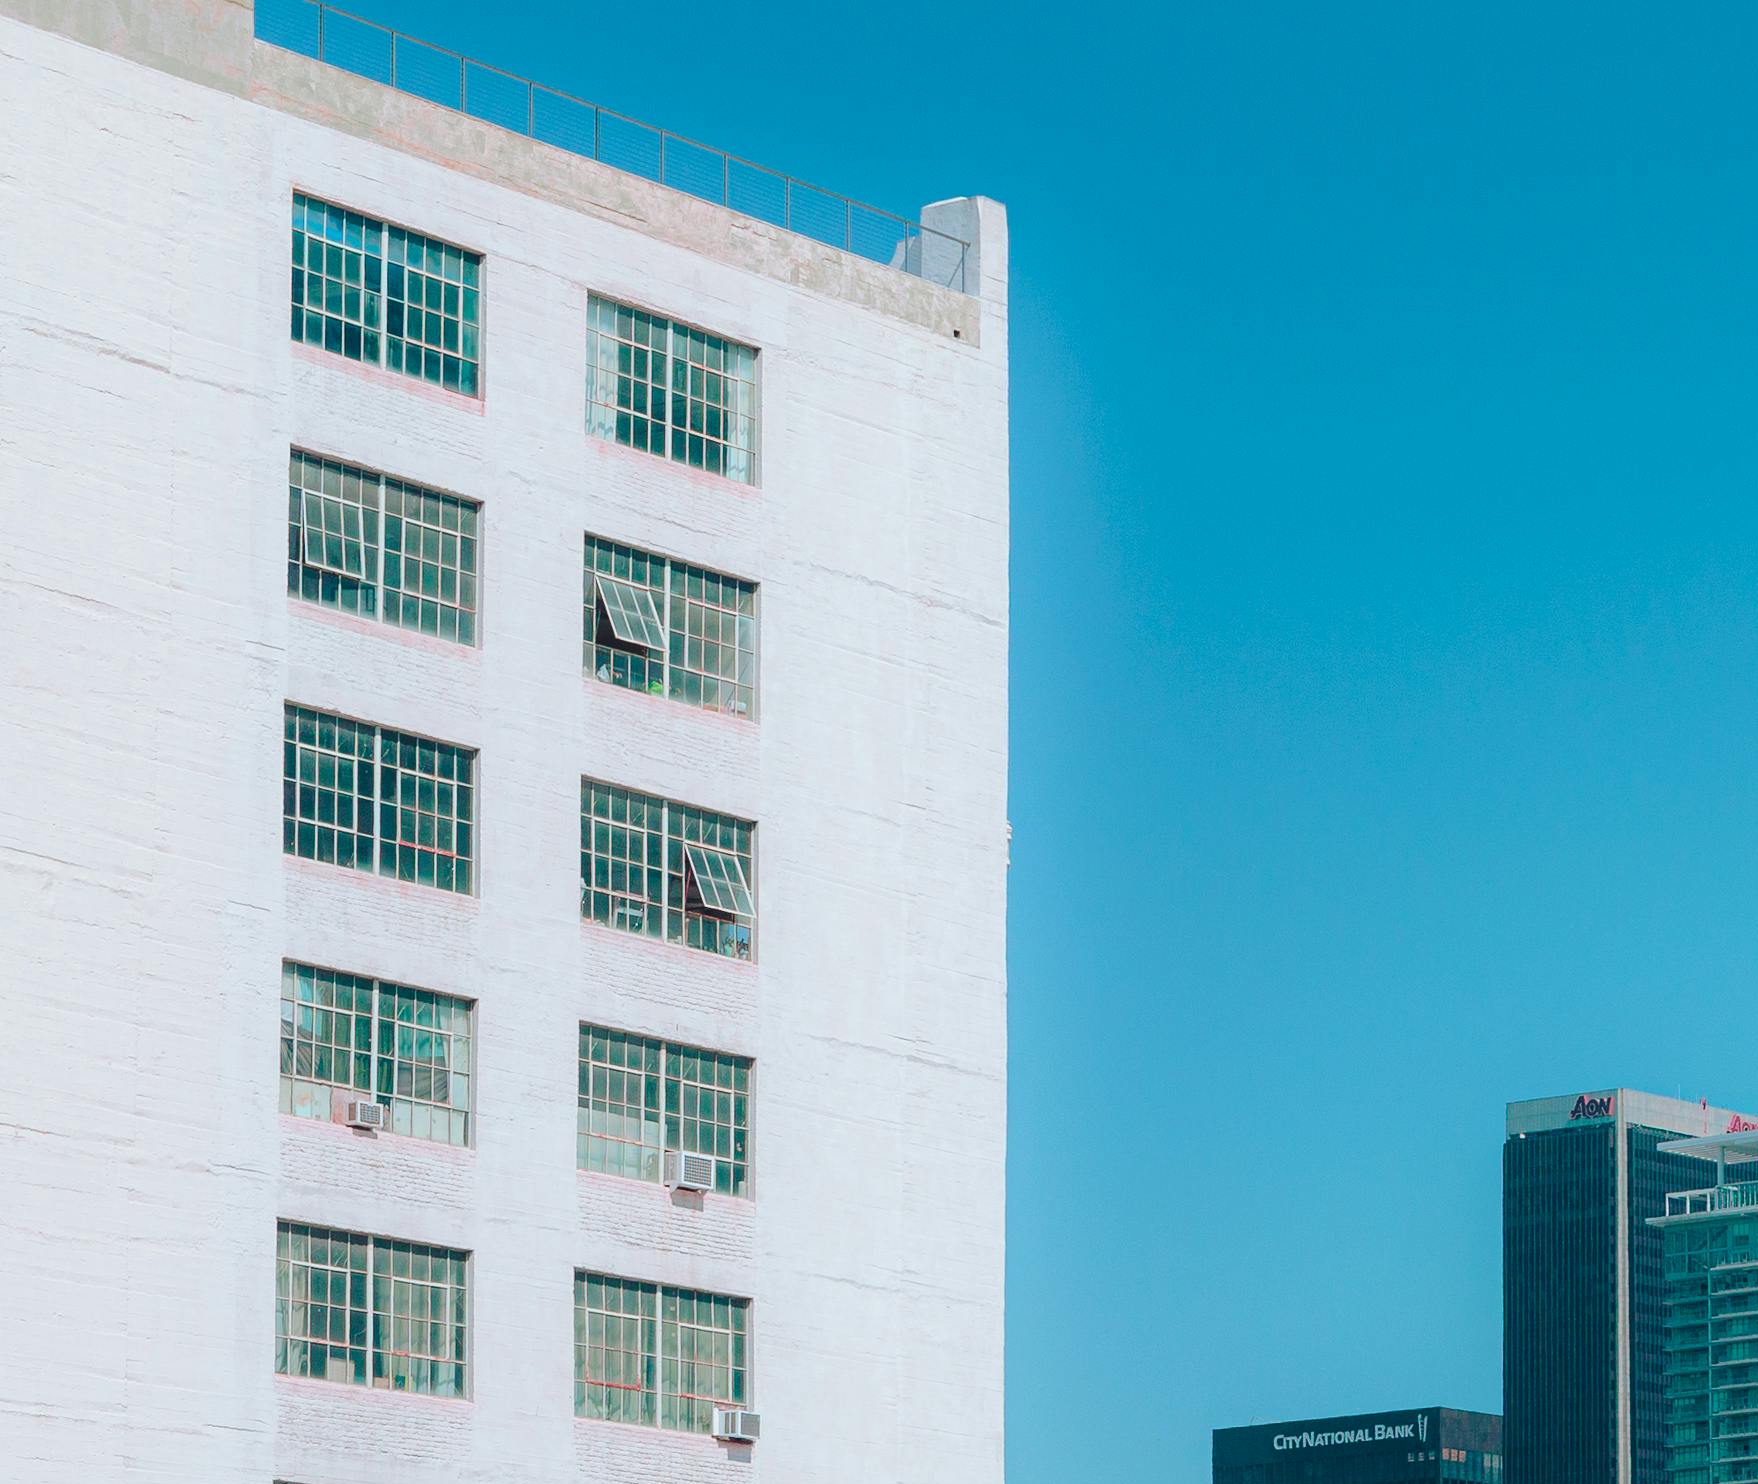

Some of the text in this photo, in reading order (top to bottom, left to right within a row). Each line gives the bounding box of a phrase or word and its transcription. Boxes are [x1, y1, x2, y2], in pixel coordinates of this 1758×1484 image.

[1570, 1095, 1616, 1120] AON
[1273, 1424, 1414, 1449] CITY NATIONAL BANK
